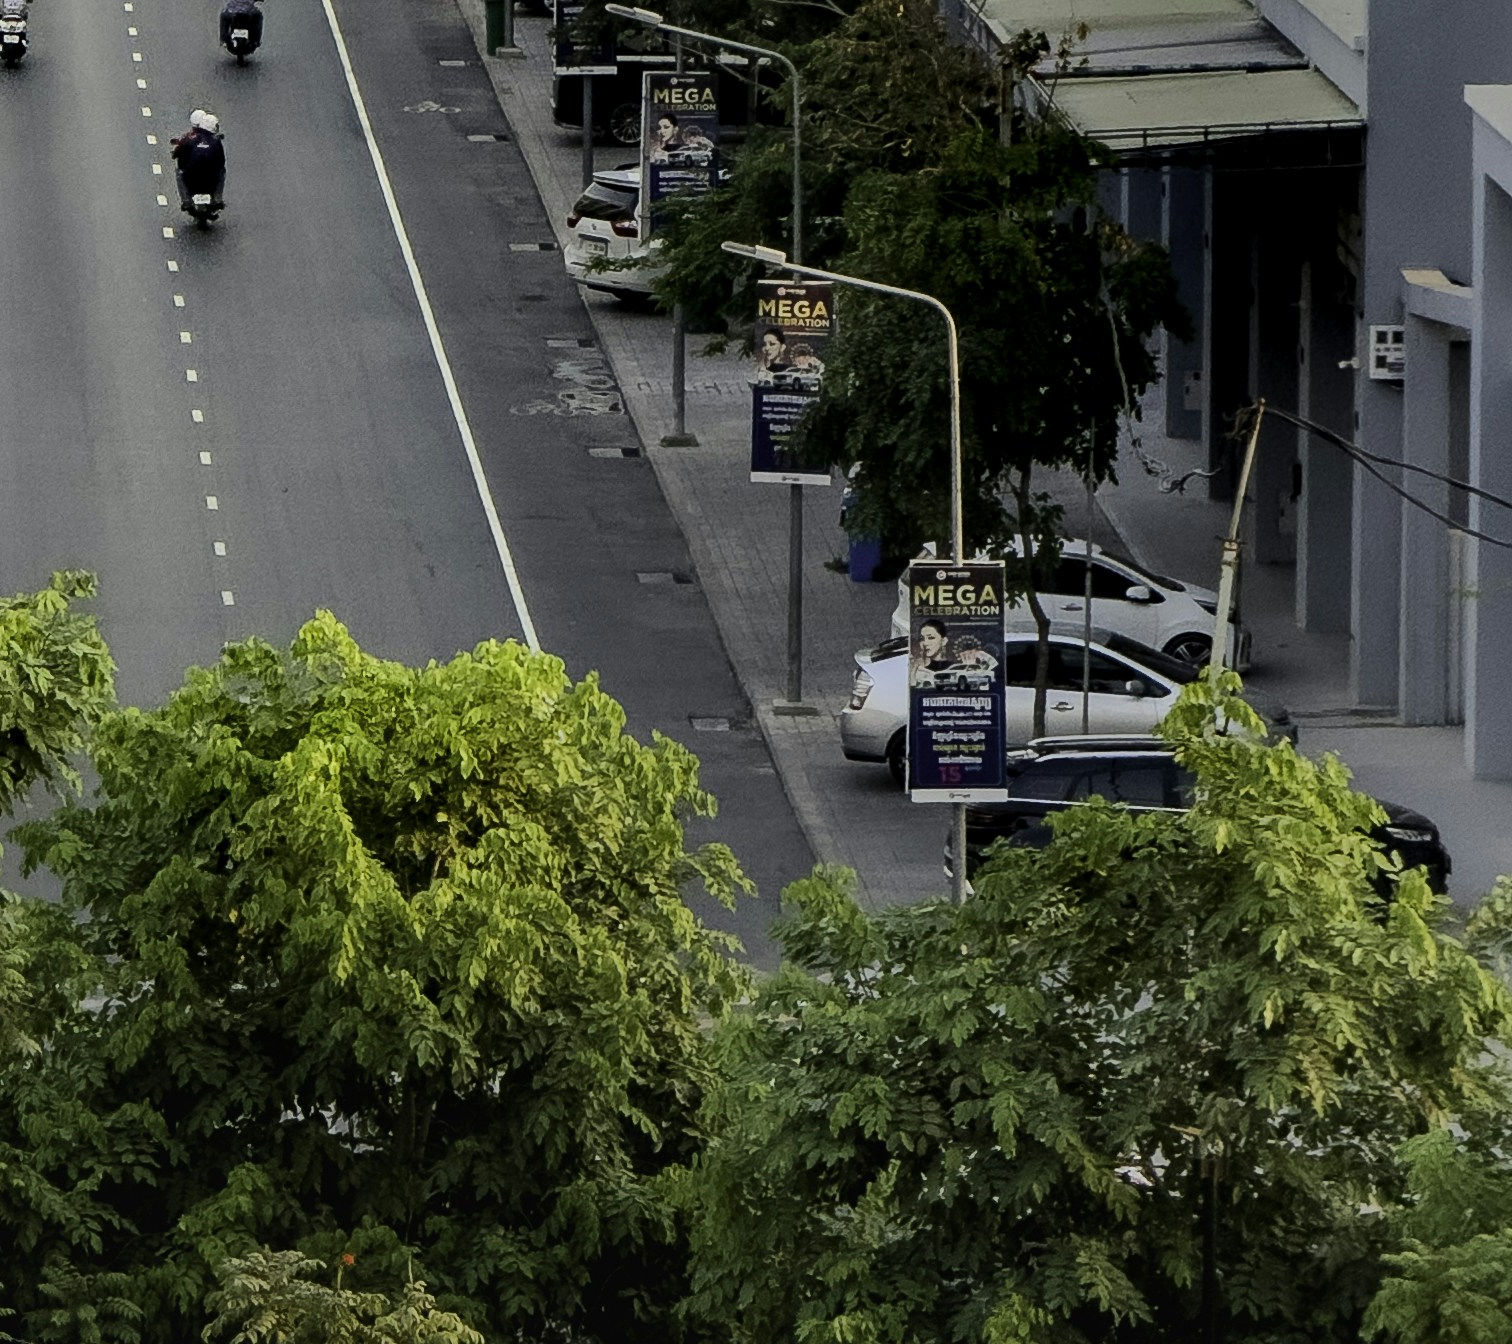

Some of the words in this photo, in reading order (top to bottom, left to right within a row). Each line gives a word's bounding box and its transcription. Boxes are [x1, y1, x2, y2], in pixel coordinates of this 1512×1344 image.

[654, 87, 715, 104] MEGA
[758, 298, 829, 318] MEGA
[759, 316, 830, 328] CELEBRATION
[914, 584, 999, 606] MEGA
[914, 605, 1000, 617] CELEBRATION
